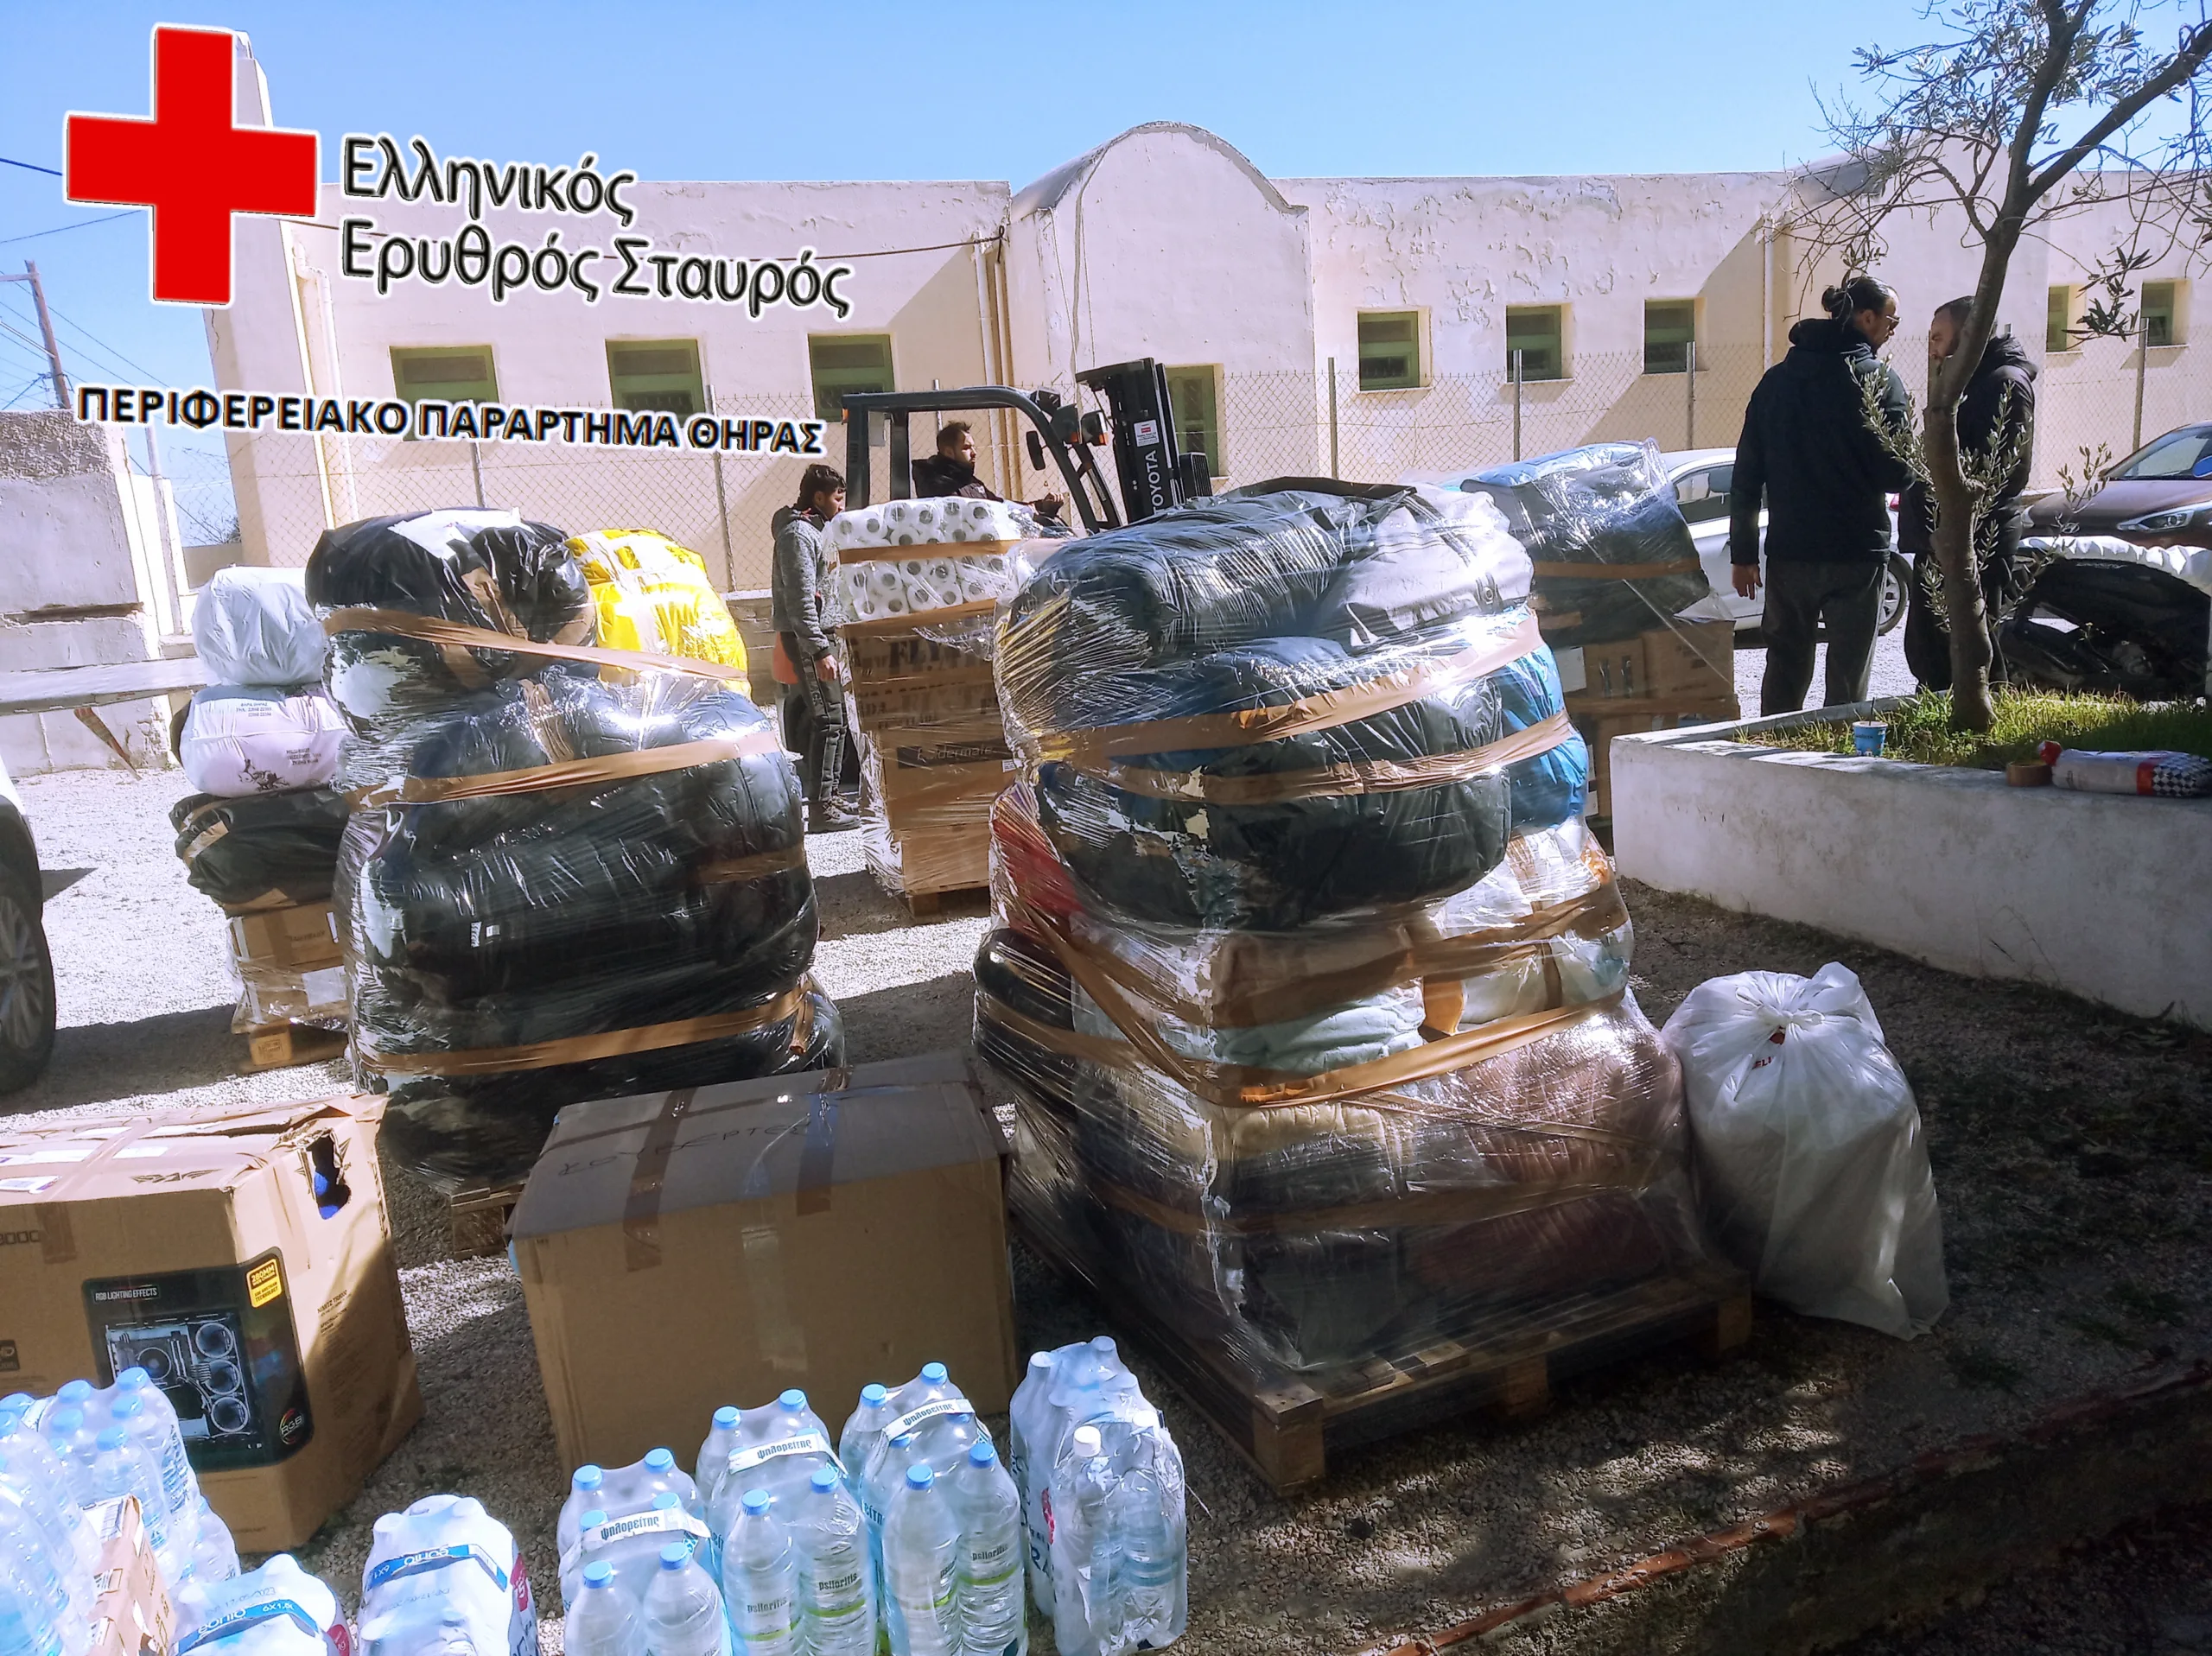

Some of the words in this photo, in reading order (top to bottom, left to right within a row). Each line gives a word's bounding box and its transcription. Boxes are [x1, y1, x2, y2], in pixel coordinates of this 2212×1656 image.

[1145, 450, 1164, 515] TOYOTA
[95, 1292, 106, 1301] RGB
[107, 1290, 132, 1300] LIGHTING
[132, 1287, 157, 1298] EFFECTS
[281, 1415, 302, 1434] RGB
